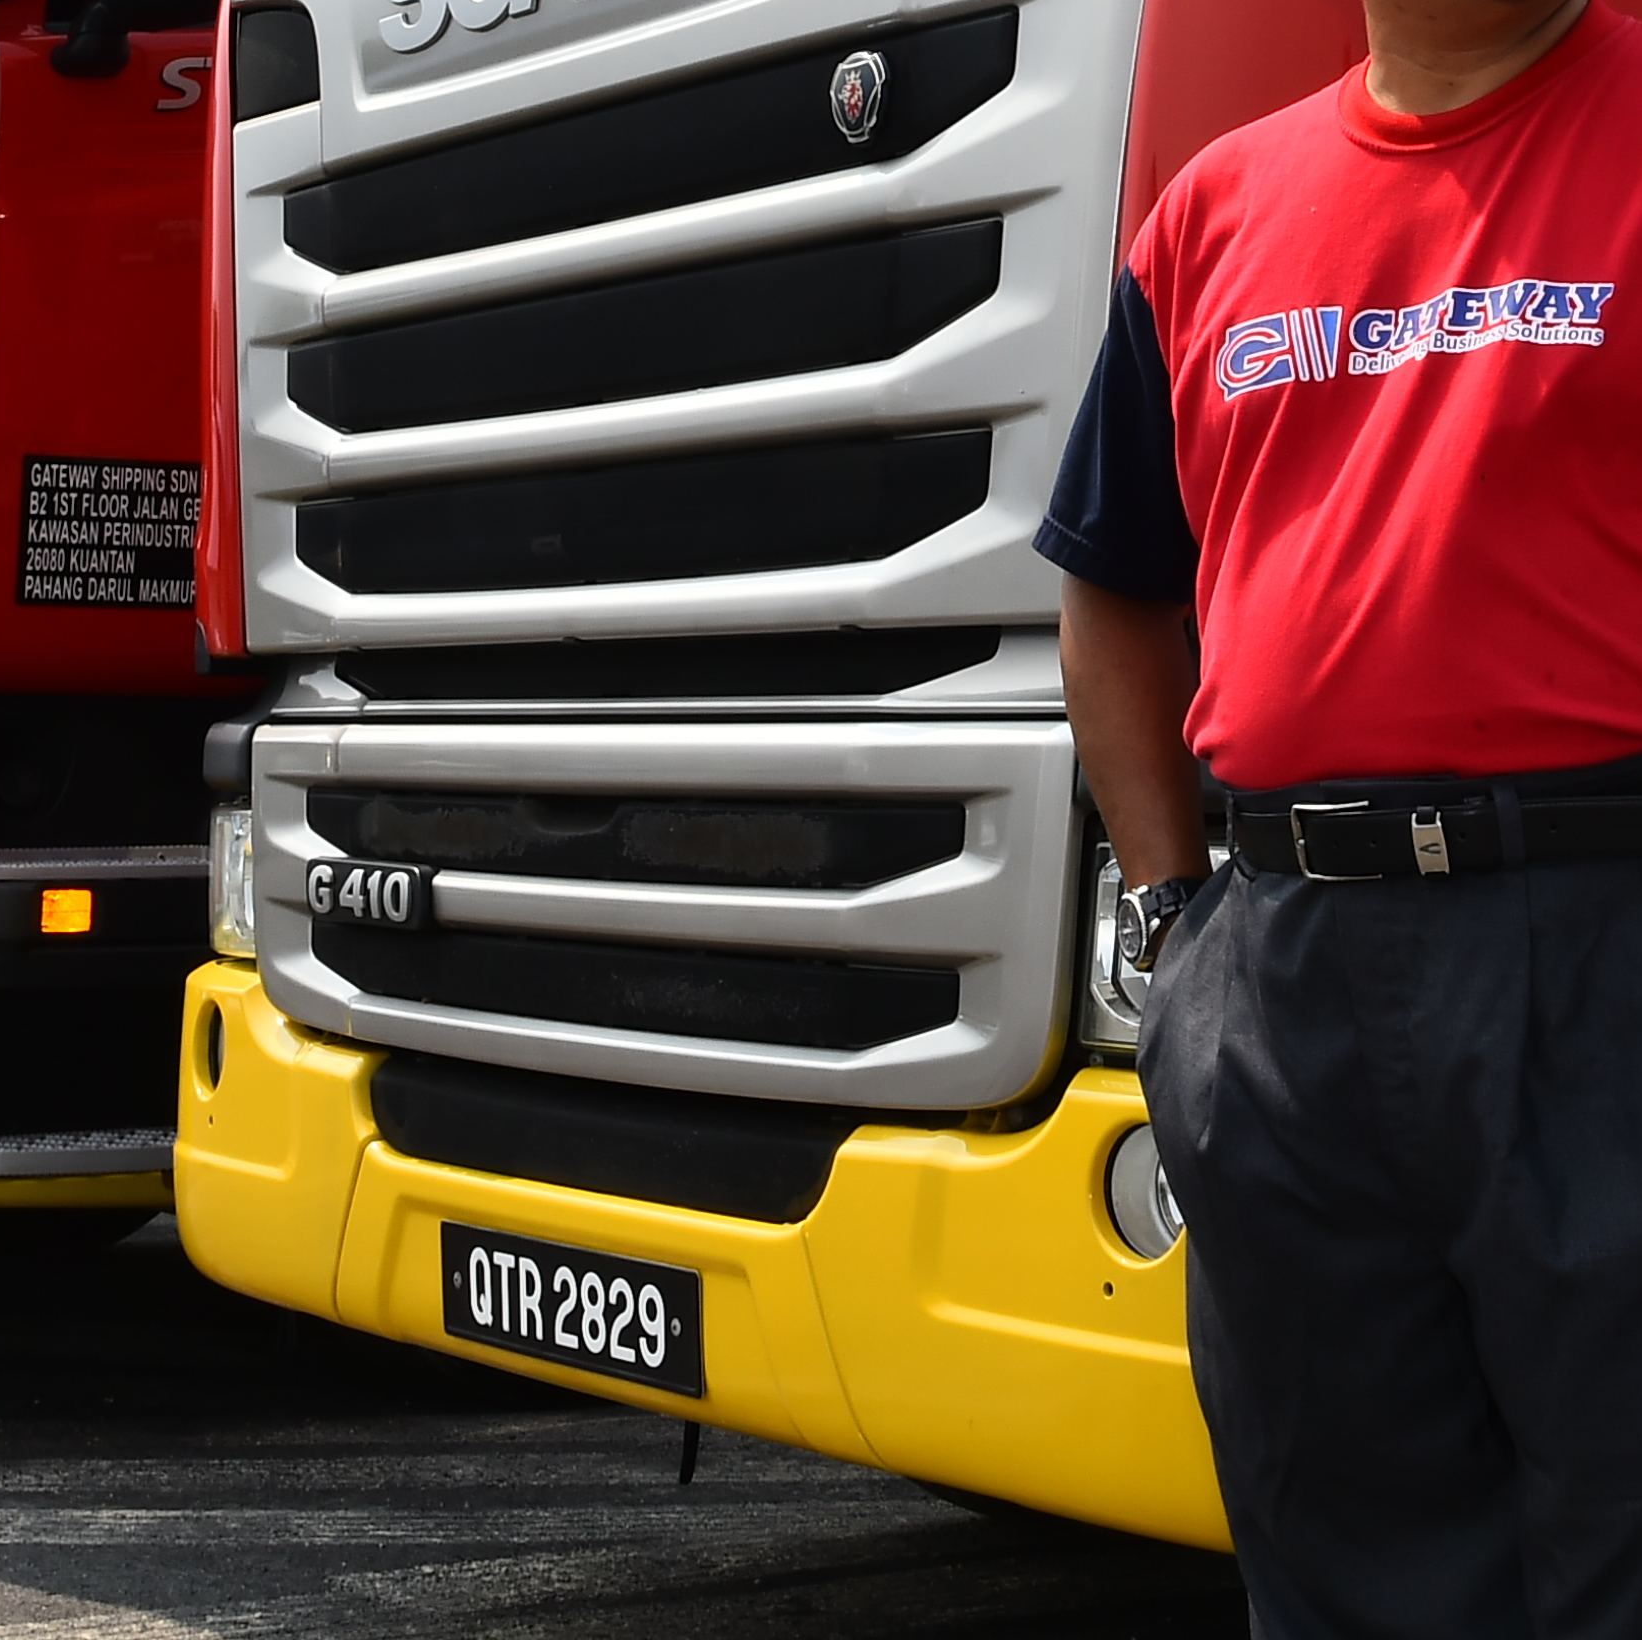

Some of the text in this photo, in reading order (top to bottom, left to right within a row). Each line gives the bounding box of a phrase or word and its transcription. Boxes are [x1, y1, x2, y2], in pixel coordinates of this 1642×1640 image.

[1350, 278, 1615, 352] GATEWAY
[1429, 320, 1604, 353] Business Solutions
[31, 464, 199, 494] GATEWAY SHIPPING SDN
[29, 491, 202, 522] B2 1ST FLOOR JALAN GE
[28, 519, 195, 549] KAWASAN PERINDUSTRI
[26, 547, 135, 574] 26080 KUANTAN
[24, 576, 83, 601] PAHANG
[87, 577, 134, 602] DARUL
[308, 864, 411, 922] G 410
[469, 1247, 666, 1368] QTR 2829
